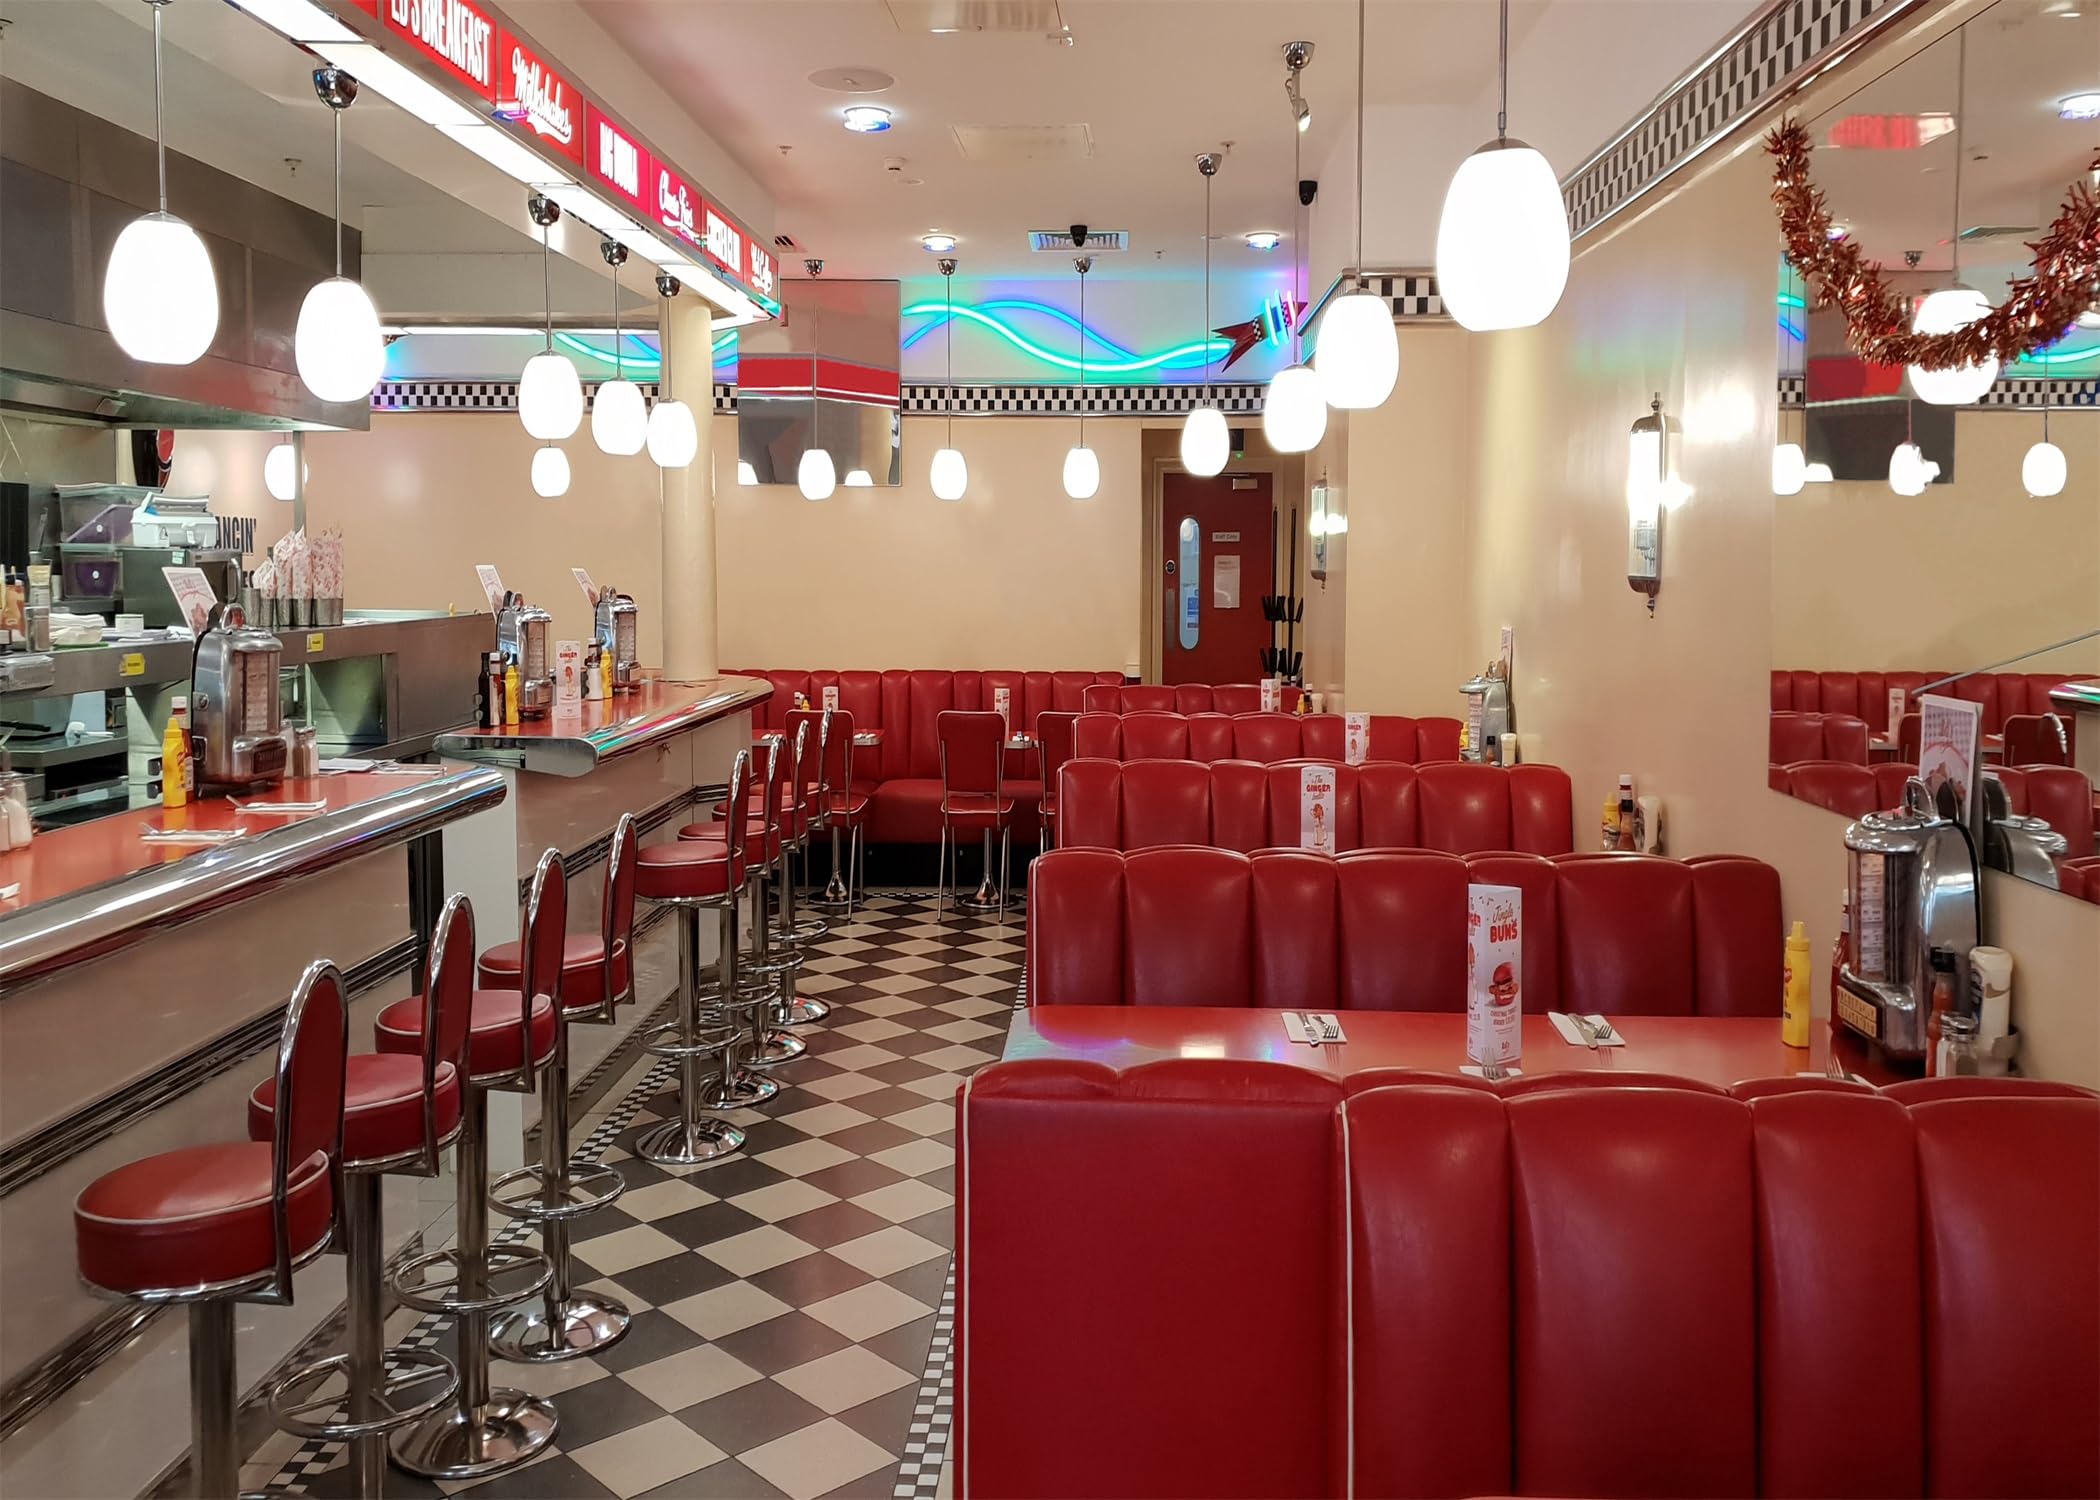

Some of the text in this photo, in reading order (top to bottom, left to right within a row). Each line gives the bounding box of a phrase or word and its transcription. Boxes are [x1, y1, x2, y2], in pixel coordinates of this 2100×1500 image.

[421, 0, 490, 88] BREAKFAST
[512, 46, 572, 144] Milkshakes
[214, 515, 256, 553] ANCIN'
[1490, 921, 1518, 943] BUNS
